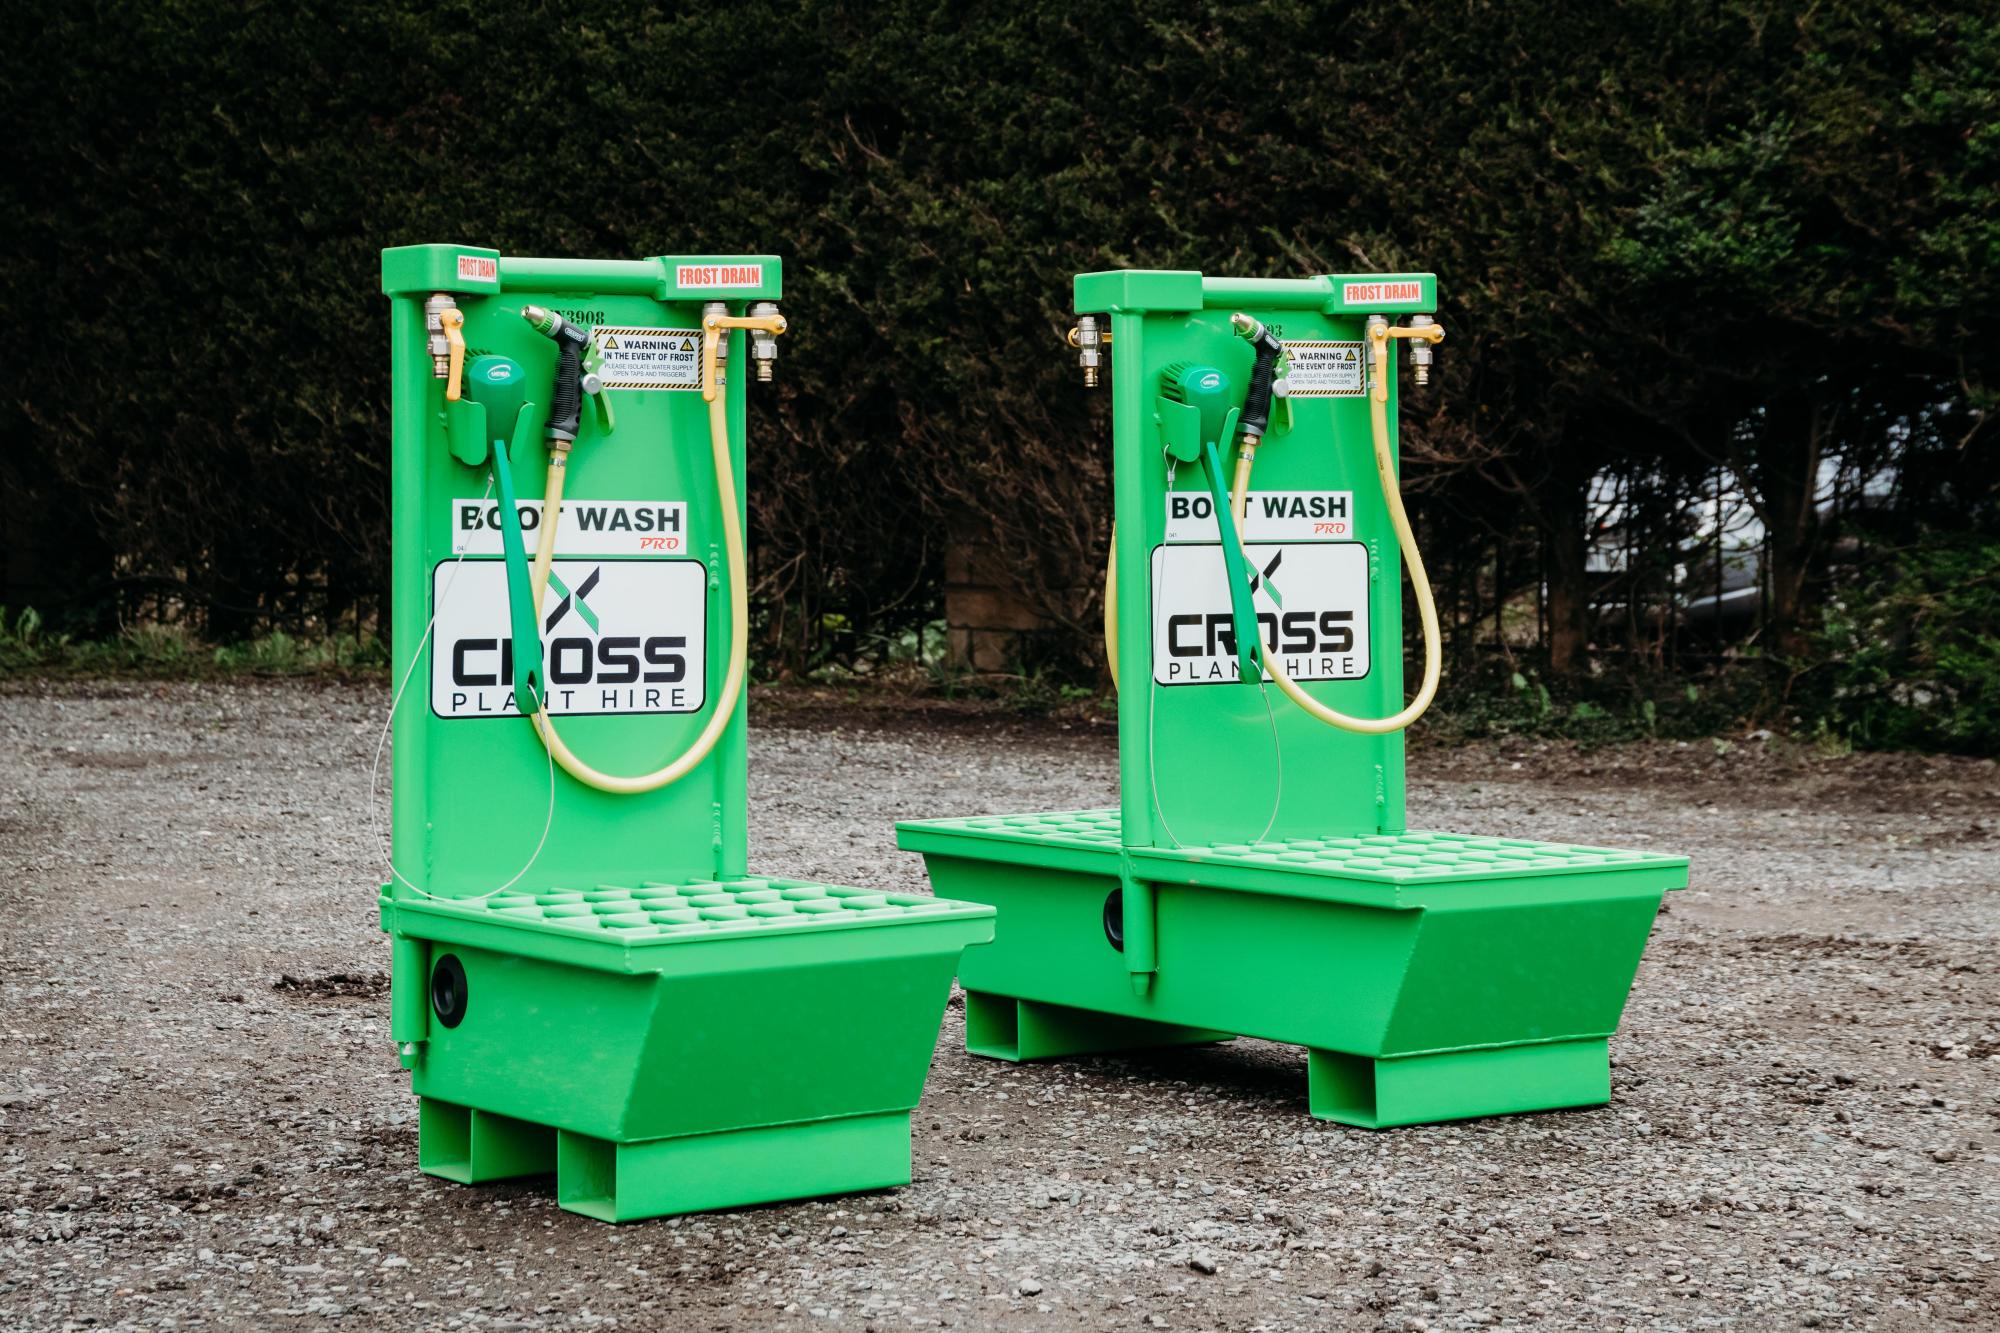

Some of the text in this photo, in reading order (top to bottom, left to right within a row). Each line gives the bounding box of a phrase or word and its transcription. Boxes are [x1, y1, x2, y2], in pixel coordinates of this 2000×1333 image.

[459, 257, 496, 278] FROST DRAIN
[679, 267, 759, 285] FROST DRAIN
[1346, 283, 1419, 301] FROST DRAIN
[624, 340, 677, 350] WARNING
[604, 351, 694, 362] IN THE EVENT OF FROST
[1299, 352, 1342, 361] WARNING
[1292, 362, 1357, 370] THE EVENT OF FROST
[1171, 496, 1347, 520] BOT WASH
[461, 505, 680, 532] BOO WASH
[1314, 523, 1346, 534] PRO
[640, 537, 679, 550] PRO
[1169, 656, 1354, 680] PLAN HIRE
[602, 688, 685, 709] HIRE
